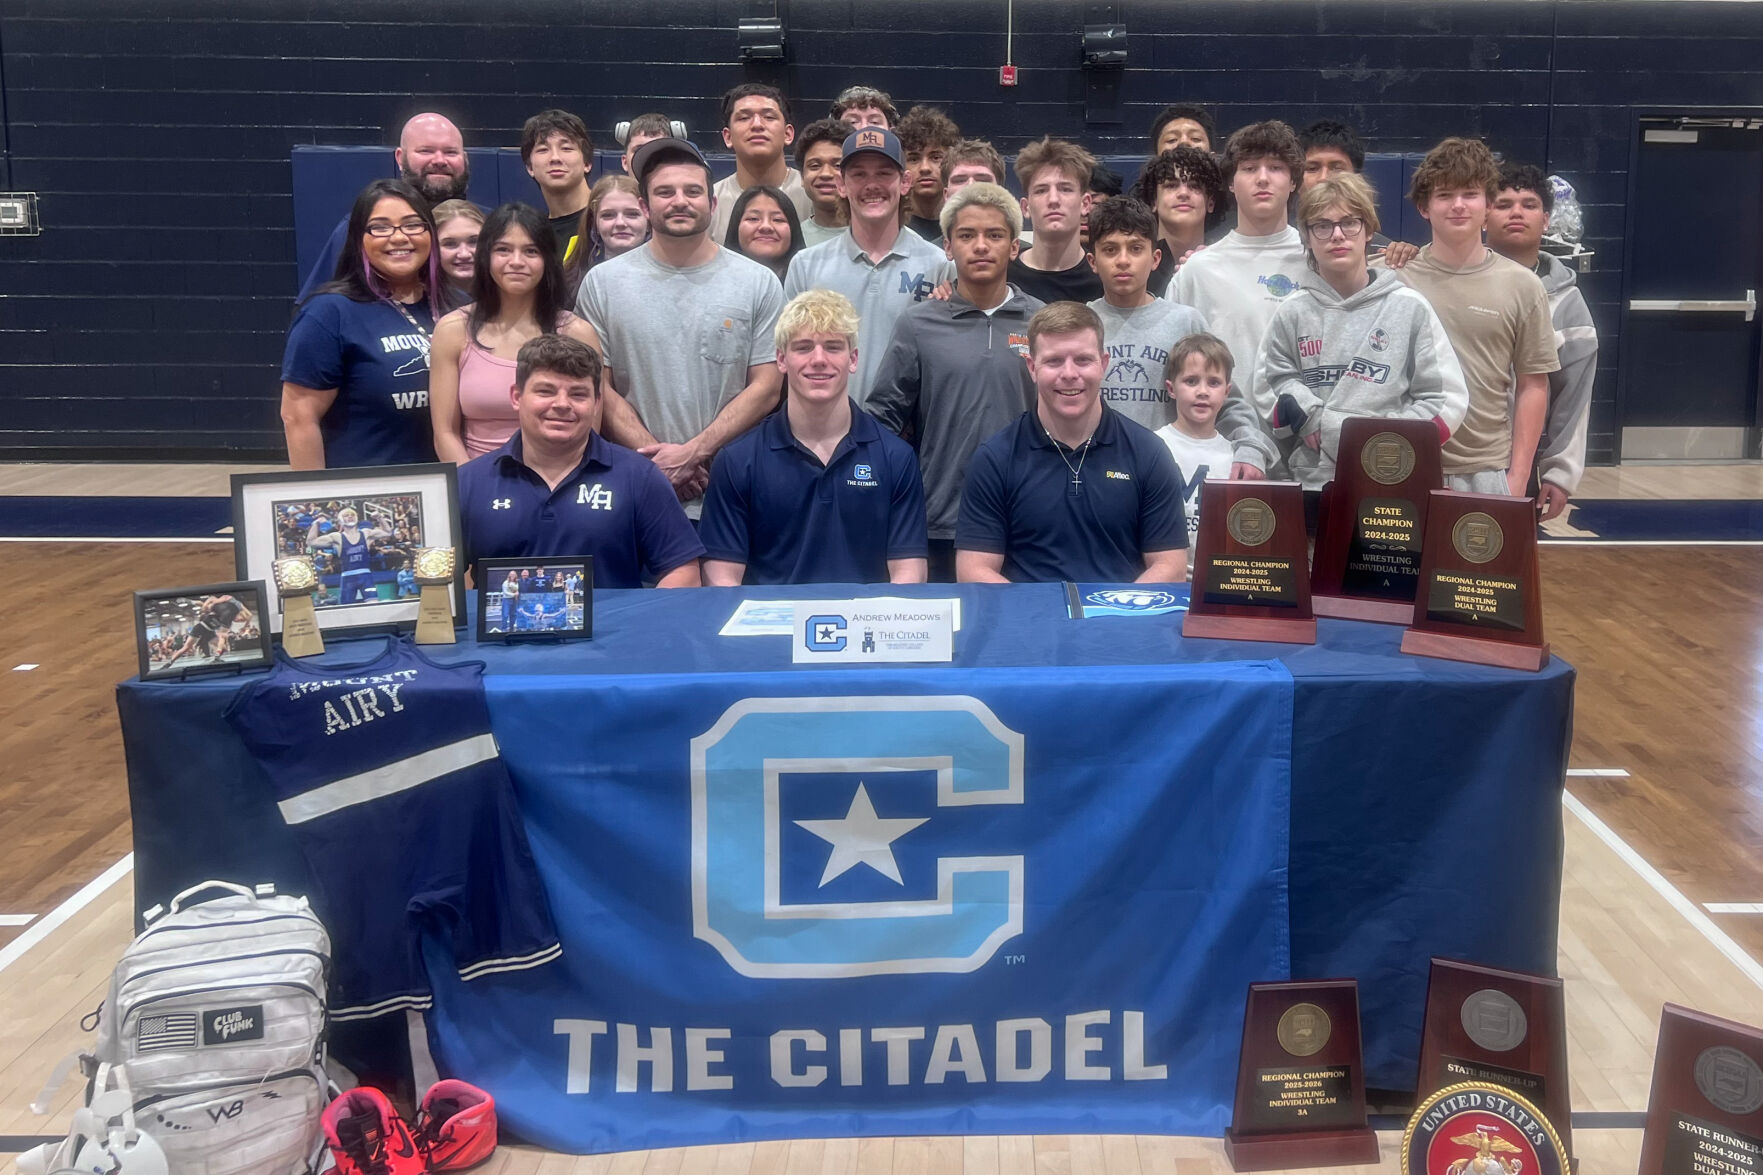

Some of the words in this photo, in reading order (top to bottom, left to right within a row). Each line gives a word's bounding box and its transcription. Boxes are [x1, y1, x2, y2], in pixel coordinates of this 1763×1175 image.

[380, 334, 433, 353] MOUN
[1299, 340, 1322, 357] 500
[1140, 345, 1169, 365] AIR
[1374, 506, 1402, 516] STATE
[1363, 517, 1413, 528] CHAMPION
[1364, 531, 1410, 541] 2024-2025
[1251, 561, 1289, 569] CHAMPION
[1362, 553, 1412, 565] WRESTLING
[1350, 562, 1399, 574] INDIVIDUAL
[1220, 583, 1260, 591] INDIVIDUAL
[1230, 577, 1271, 585] WRESTLING
[1383, 578, 1390, 587] A
[1436, 574, 1474, 585] REGIONAL
[1475, 579, 1517, 590] CHAMPION
[1457, 585, 1494, 596] 2024-2025
[1454, 594, 1497, 606] WRESTLING
[1454, 602, 1474, 610] DUAL
[1476, 604, 1497, 613] TEAM
[325, 683, 404, 735] AIRY
[1004, 954, 1025, 965] TM
[213, 1011, 243, 1034] CLUB
[222, 1017, 254, 1040] FUNK
[552, 1018, 734, 1094] THE
[769, 1009, 1168, 1088] CITADEL
[1447, 1063, 1477, 1076] STATE
[1261, 1073, 1302, 1082] REGIONAL
[1303, 1071, 1345, 1080] CHAMPION
[1284, 1080, 1322, 1089] 2025-2026
[1281, 1090, 1326, 1099] WRESTLING
[1269, 1098, 1314, 1107] INDIVIDUAL
[1316, 1097, 1337, 1105] TEAM
[1422, 1093, 1482, 1132] UNITED
[1485, 1095, 1546, 1146] STATES
[1678, 1120, 1711, 1138] STATE
[1698, 1140, 1754, 1165] 2024-2025
